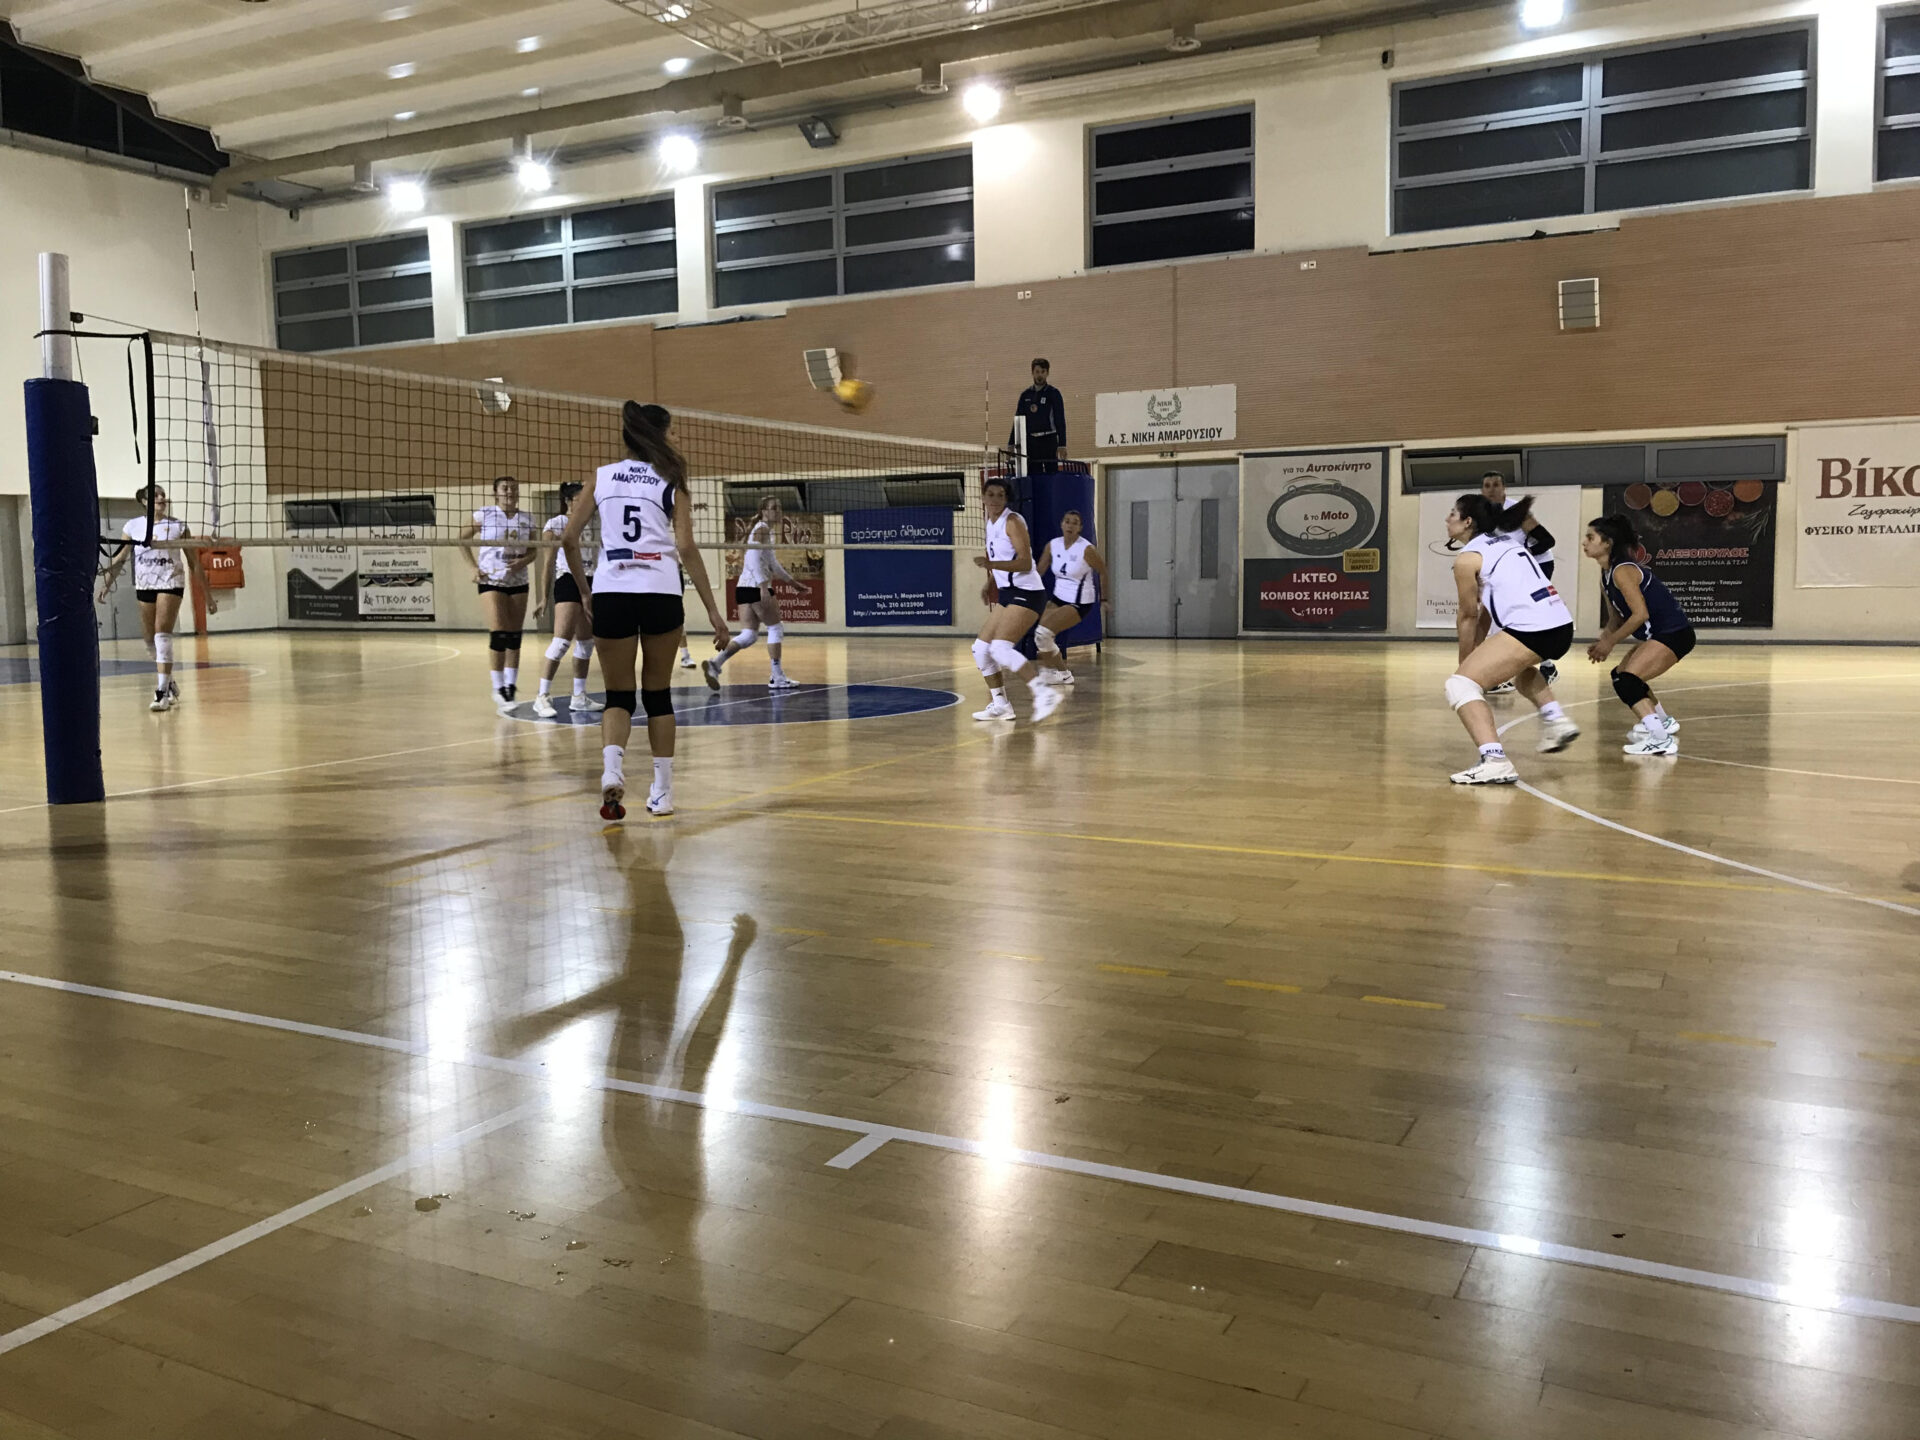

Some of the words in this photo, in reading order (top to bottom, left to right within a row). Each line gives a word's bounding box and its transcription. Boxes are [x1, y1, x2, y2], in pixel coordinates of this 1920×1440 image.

[1108, 433, 1117, 445] Α.
[1120, 433, 1129, 444] Σ.
[1132, 431, 1155, 443] ΝΙΚΗ
[1157, 427, 1223, 442] ΑΜΑΡΟΥΣΙΟΥ
[628, 466, 648, 474] ΝΙΚΗ
[1282, 467, 1294, 475] για
[1306, 461, 1372, 473] Αυτοκίνητο
[612, 472, 660, 486] ΑΜΑΡΟΥΣΙΟΥ
[1320, 510, 1350, 521] Moto
[622, 504, 642, 543] 5
[1804, 525, 1853, 536] ΦΥΣΙΚΟ
[989, 541, 995, 559] 6
[1655, 547, 1750, 559] ΑΛΕΞΟΠΟΥΛΟΣ
[1060, 562, 1068, 576] 4
[1516, 551, 1541, 580] 7
[1292, 572, 1338, 583] Ι.ΚΤΕΟ
[1260, 591, 1310, 601] ΚΟΜΒΟΣ
[1313, 591, 1370, 600] ΚΗΦΙΣΙΑΣ
[1305, 607, 1334, 615] 11011
